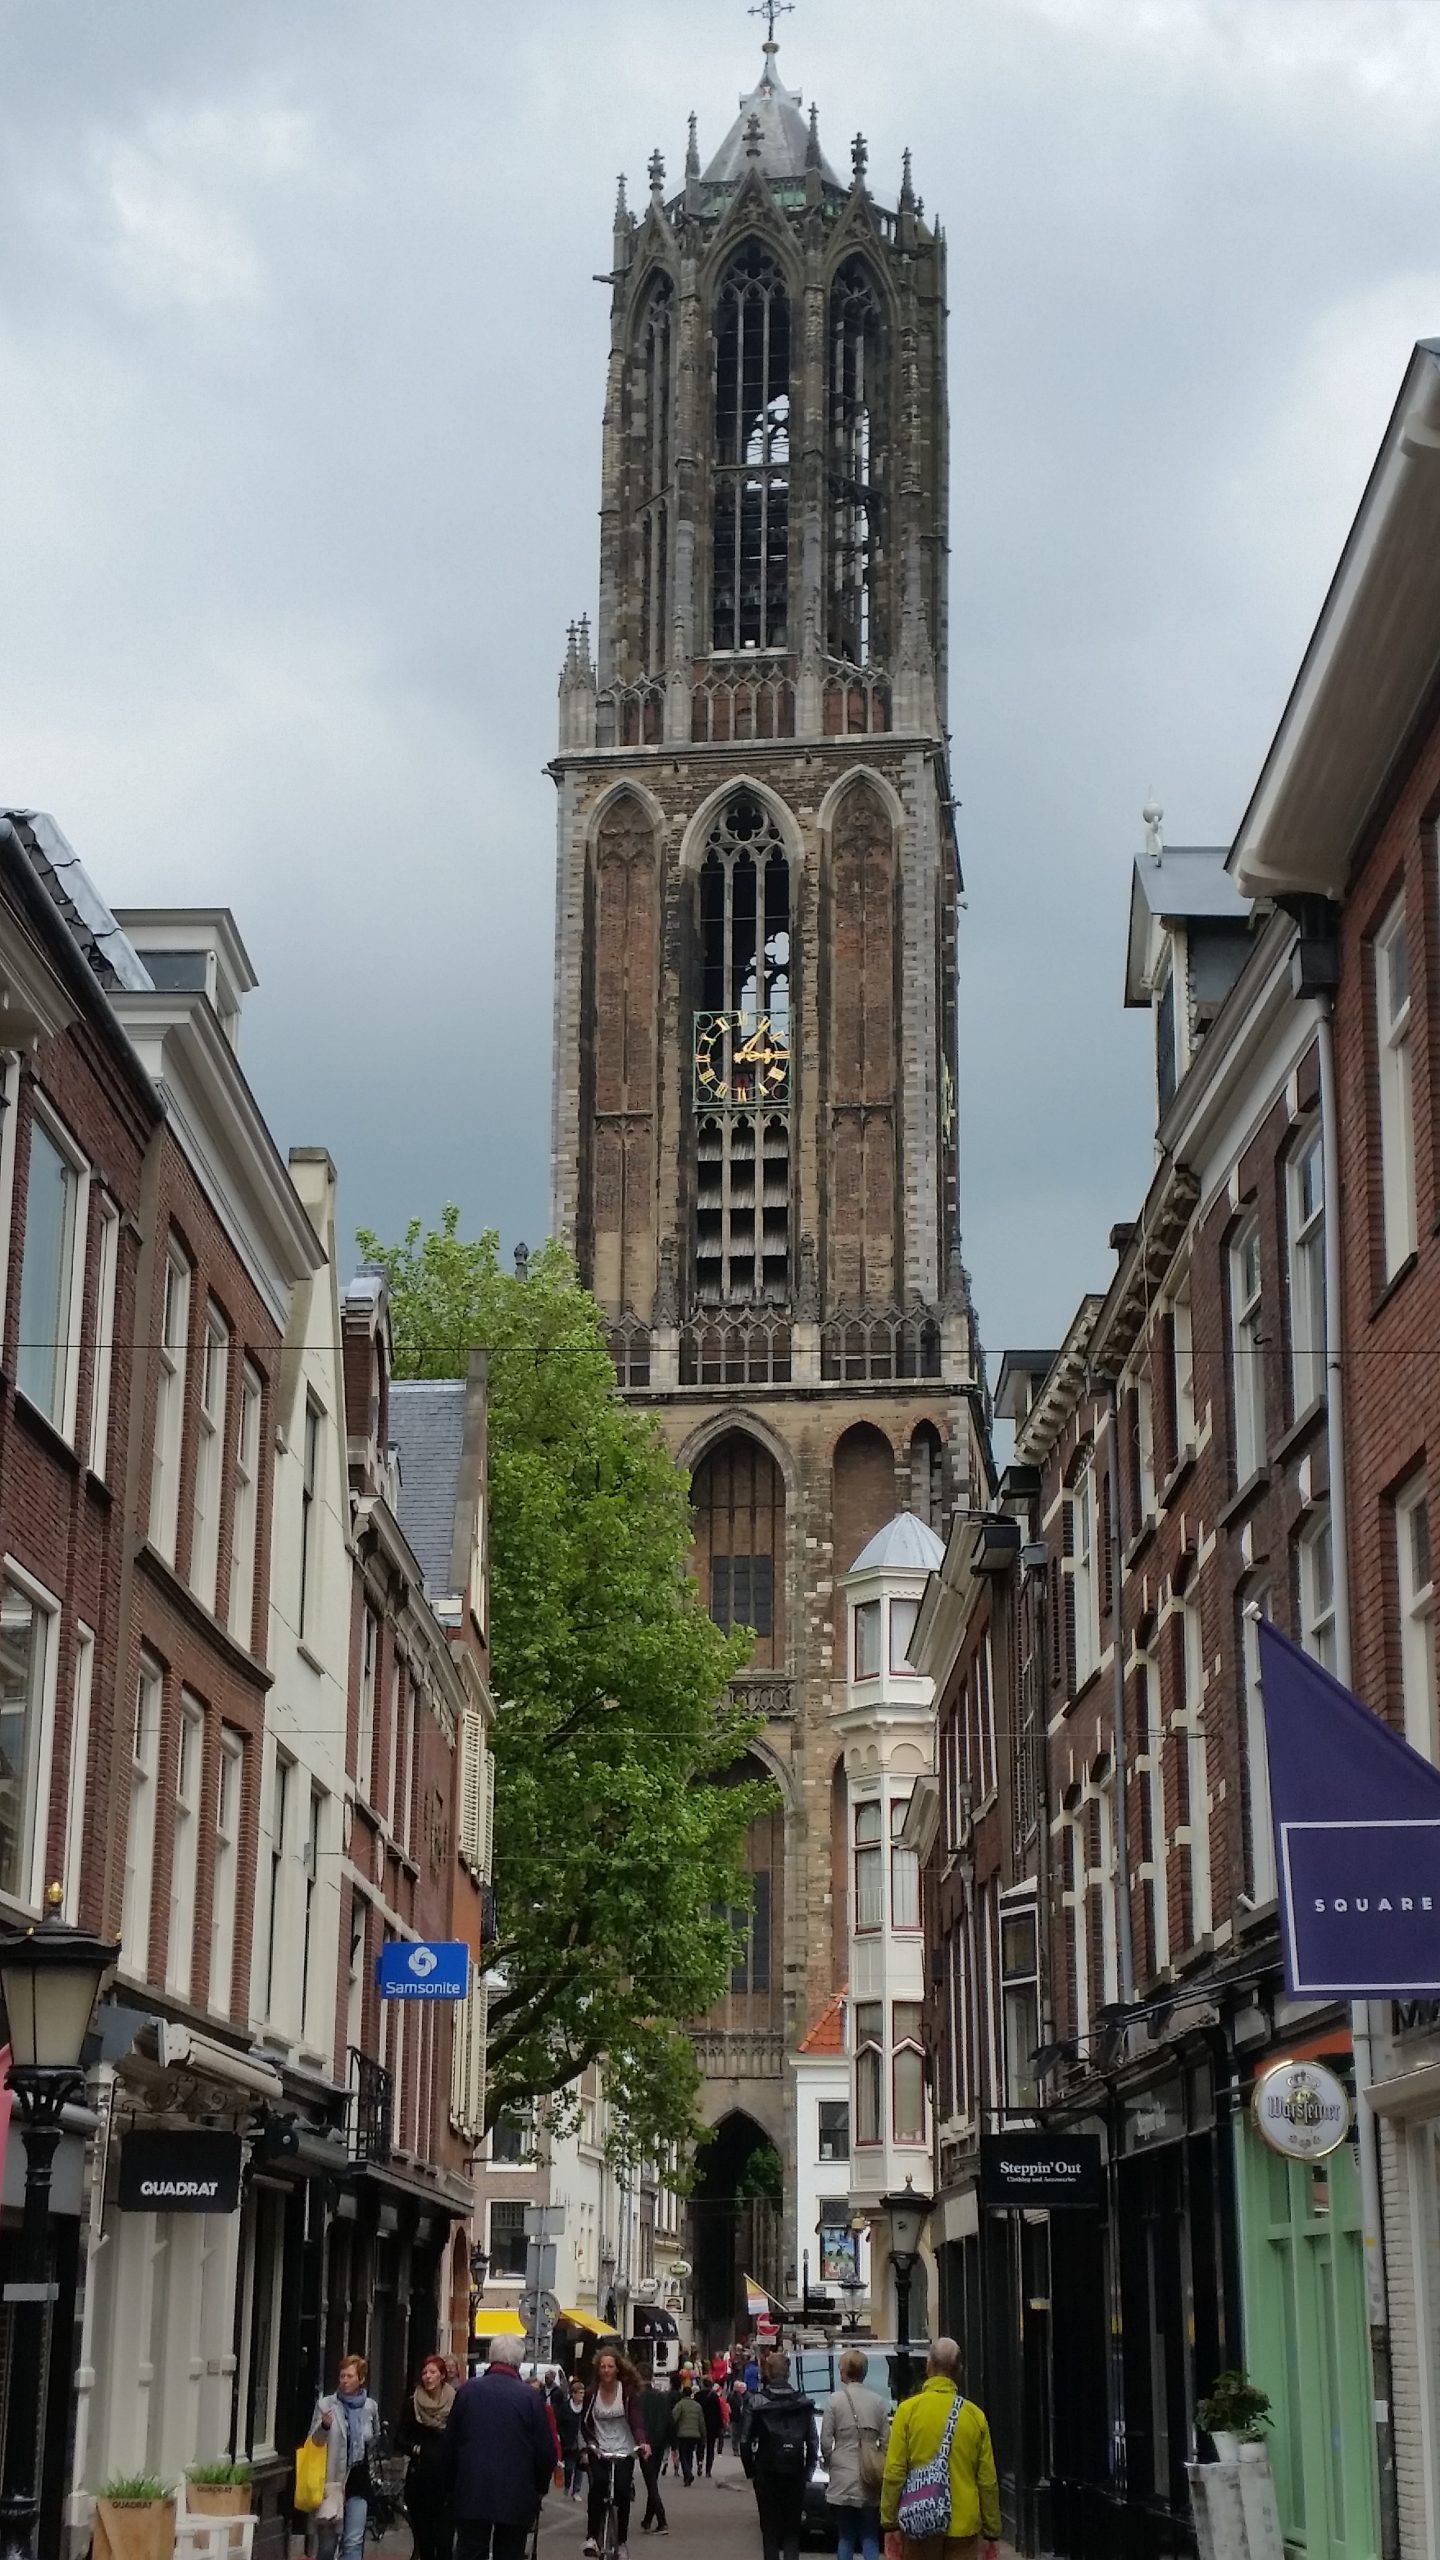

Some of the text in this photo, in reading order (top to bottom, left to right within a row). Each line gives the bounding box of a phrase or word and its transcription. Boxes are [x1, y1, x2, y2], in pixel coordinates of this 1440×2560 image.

[1314, 1897, 1433, 1913] SQUARE
[386, 1981, 460, 1994] Samsonite
[1267, 2095, 1341, 2123] Warsteiner
[1000, 2161, 1082, 2176] Steppin' Out
[141, 2181, 218, 2196] QUADRAT
[197, 2486, 232, 2494] QUADRAT
[111, 2501, 152, 2509] QUADRAT
